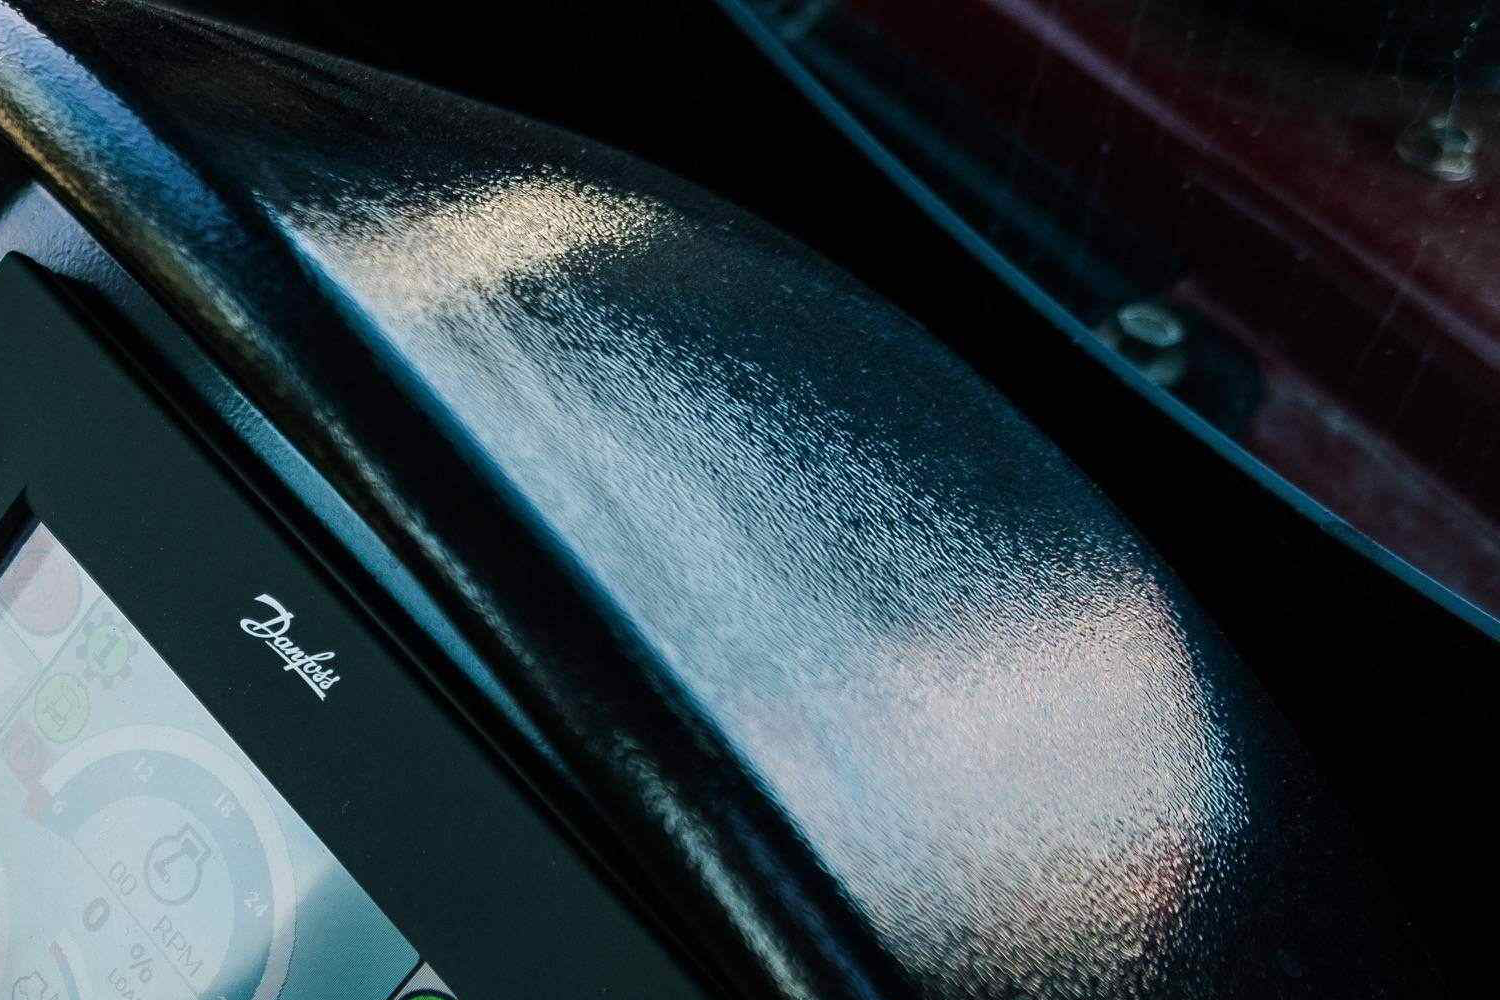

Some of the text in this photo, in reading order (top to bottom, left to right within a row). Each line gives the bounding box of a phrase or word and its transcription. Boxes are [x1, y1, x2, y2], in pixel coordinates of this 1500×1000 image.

[240, 594, 341, 701] Danfoss
[243, 887, 269, 917] 24
[83, 897, 154, 984] 0 %
[152, 915, 203, 977] RPM
